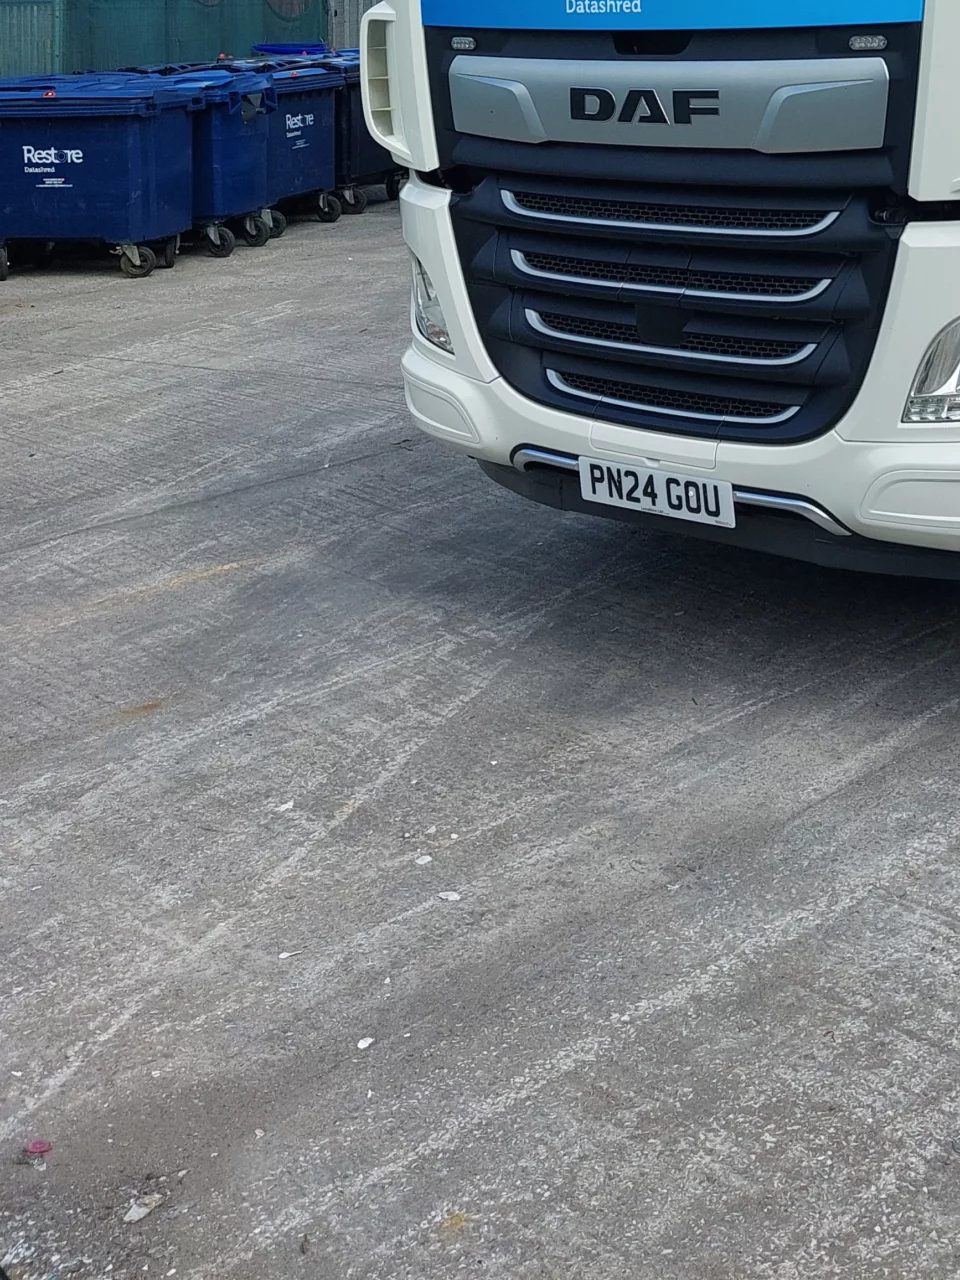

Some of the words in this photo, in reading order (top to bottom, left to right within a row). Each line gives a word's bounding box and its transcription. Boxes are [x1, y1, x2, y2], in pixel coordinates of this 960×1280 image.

[285, 113, 314, 130] Restre
[570, 86, 720, 125] DAF
[589, 463, 658, 506] PN24
[666, 477, 721, 518] GOU
